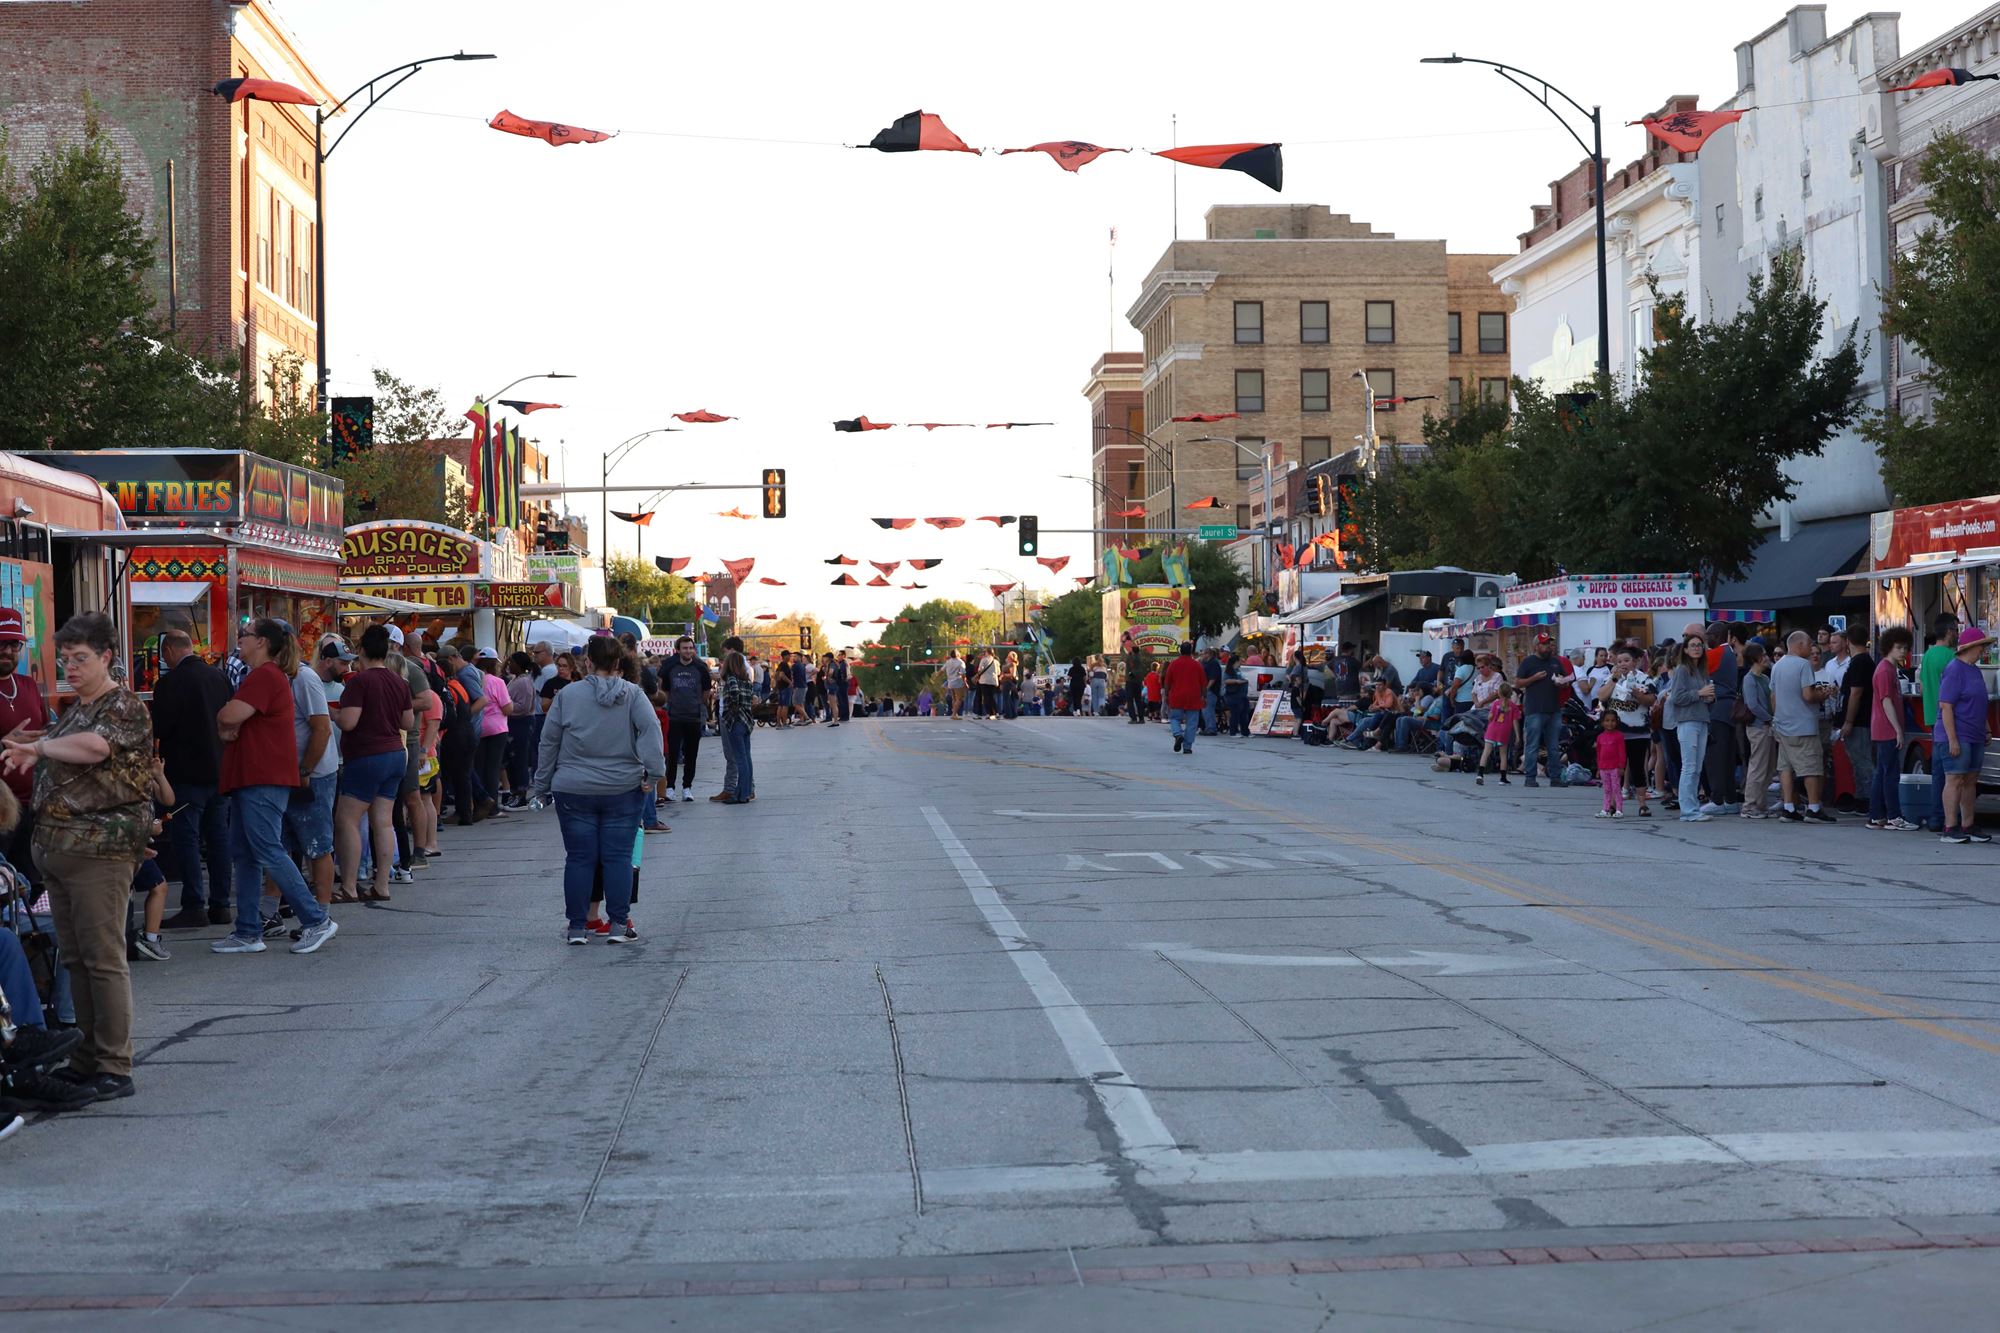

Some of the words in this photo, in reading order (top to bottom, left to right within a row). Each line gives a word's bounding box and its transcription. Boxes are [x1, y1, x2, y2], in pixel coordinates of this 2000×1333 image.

[1200, 529, 1223, 537] Laurel
[1227, 528, 1236, 537] St
[338, 530, 472, 565] AUSAGES
[374, 554, 417, 565] BRAT
[407, 563, 463, 573] POLISH
[498, 585, 538, 594] CHERRY
[1589, 582, 1618, 594] DIPPED
[1621, 581, 1673, 593] CHEESECAKE
[433, 586, 465, 606] TEA
[491, 595, 545, 606] LIMEADE
[1576, 598, 1618, 609] JUMBO
[1624, 596, 1688, 608] CORNDOGS
[640, 641, 676, 649] COOKI
